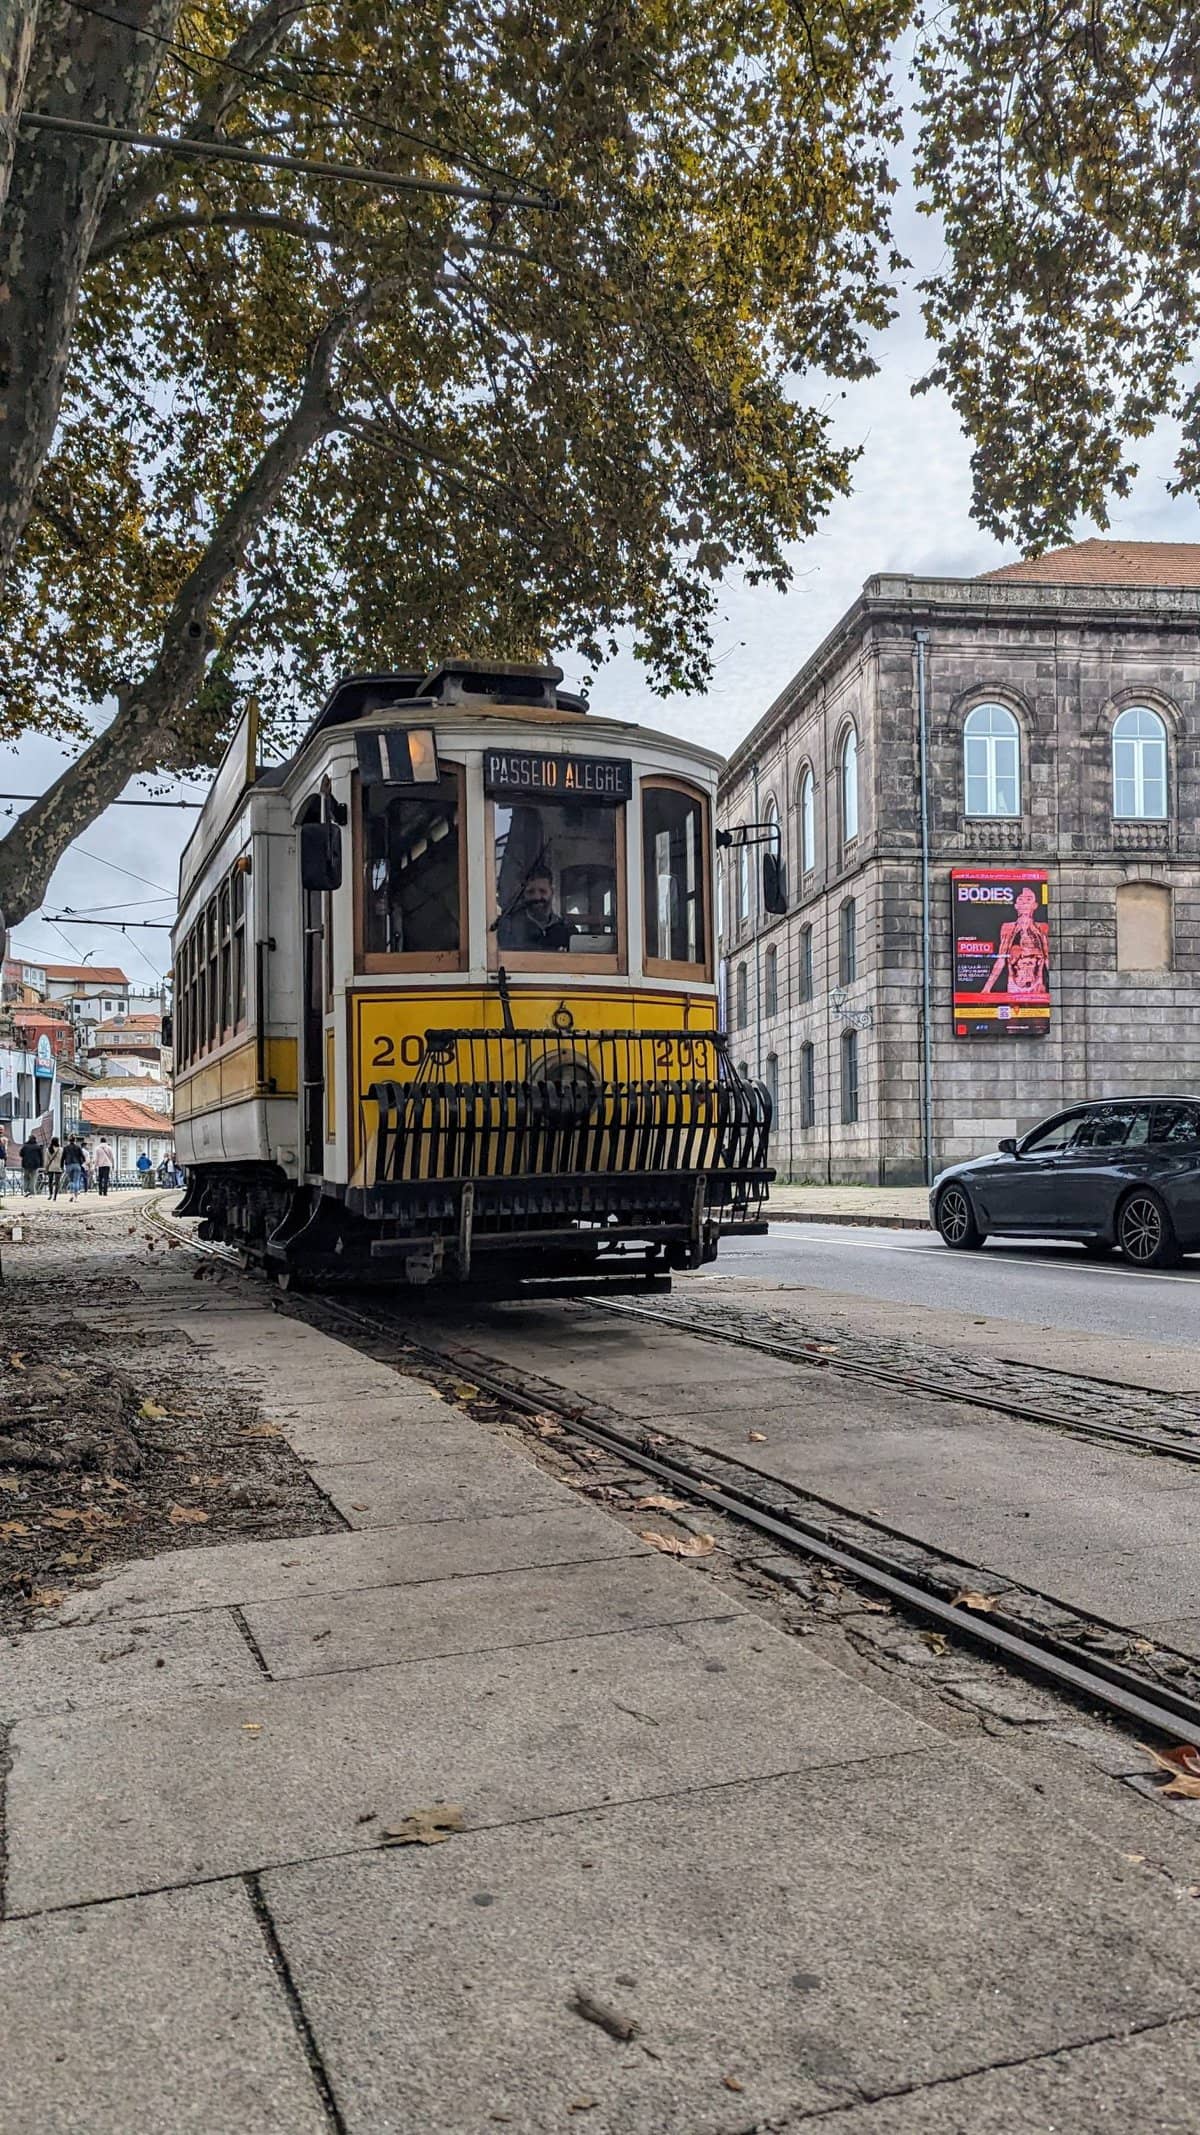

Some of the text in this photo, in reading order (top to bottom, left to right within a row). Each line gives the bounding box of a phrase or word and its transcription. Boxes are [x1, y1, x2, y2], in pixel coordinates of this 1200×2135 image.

[490, 756, 624, 792] PASSEIO ALEGRE
[958, 887, 1013, 901] BODIES
[960, 943, 991, 952] PORTO
[656, 1039, 708, 1068] 203
